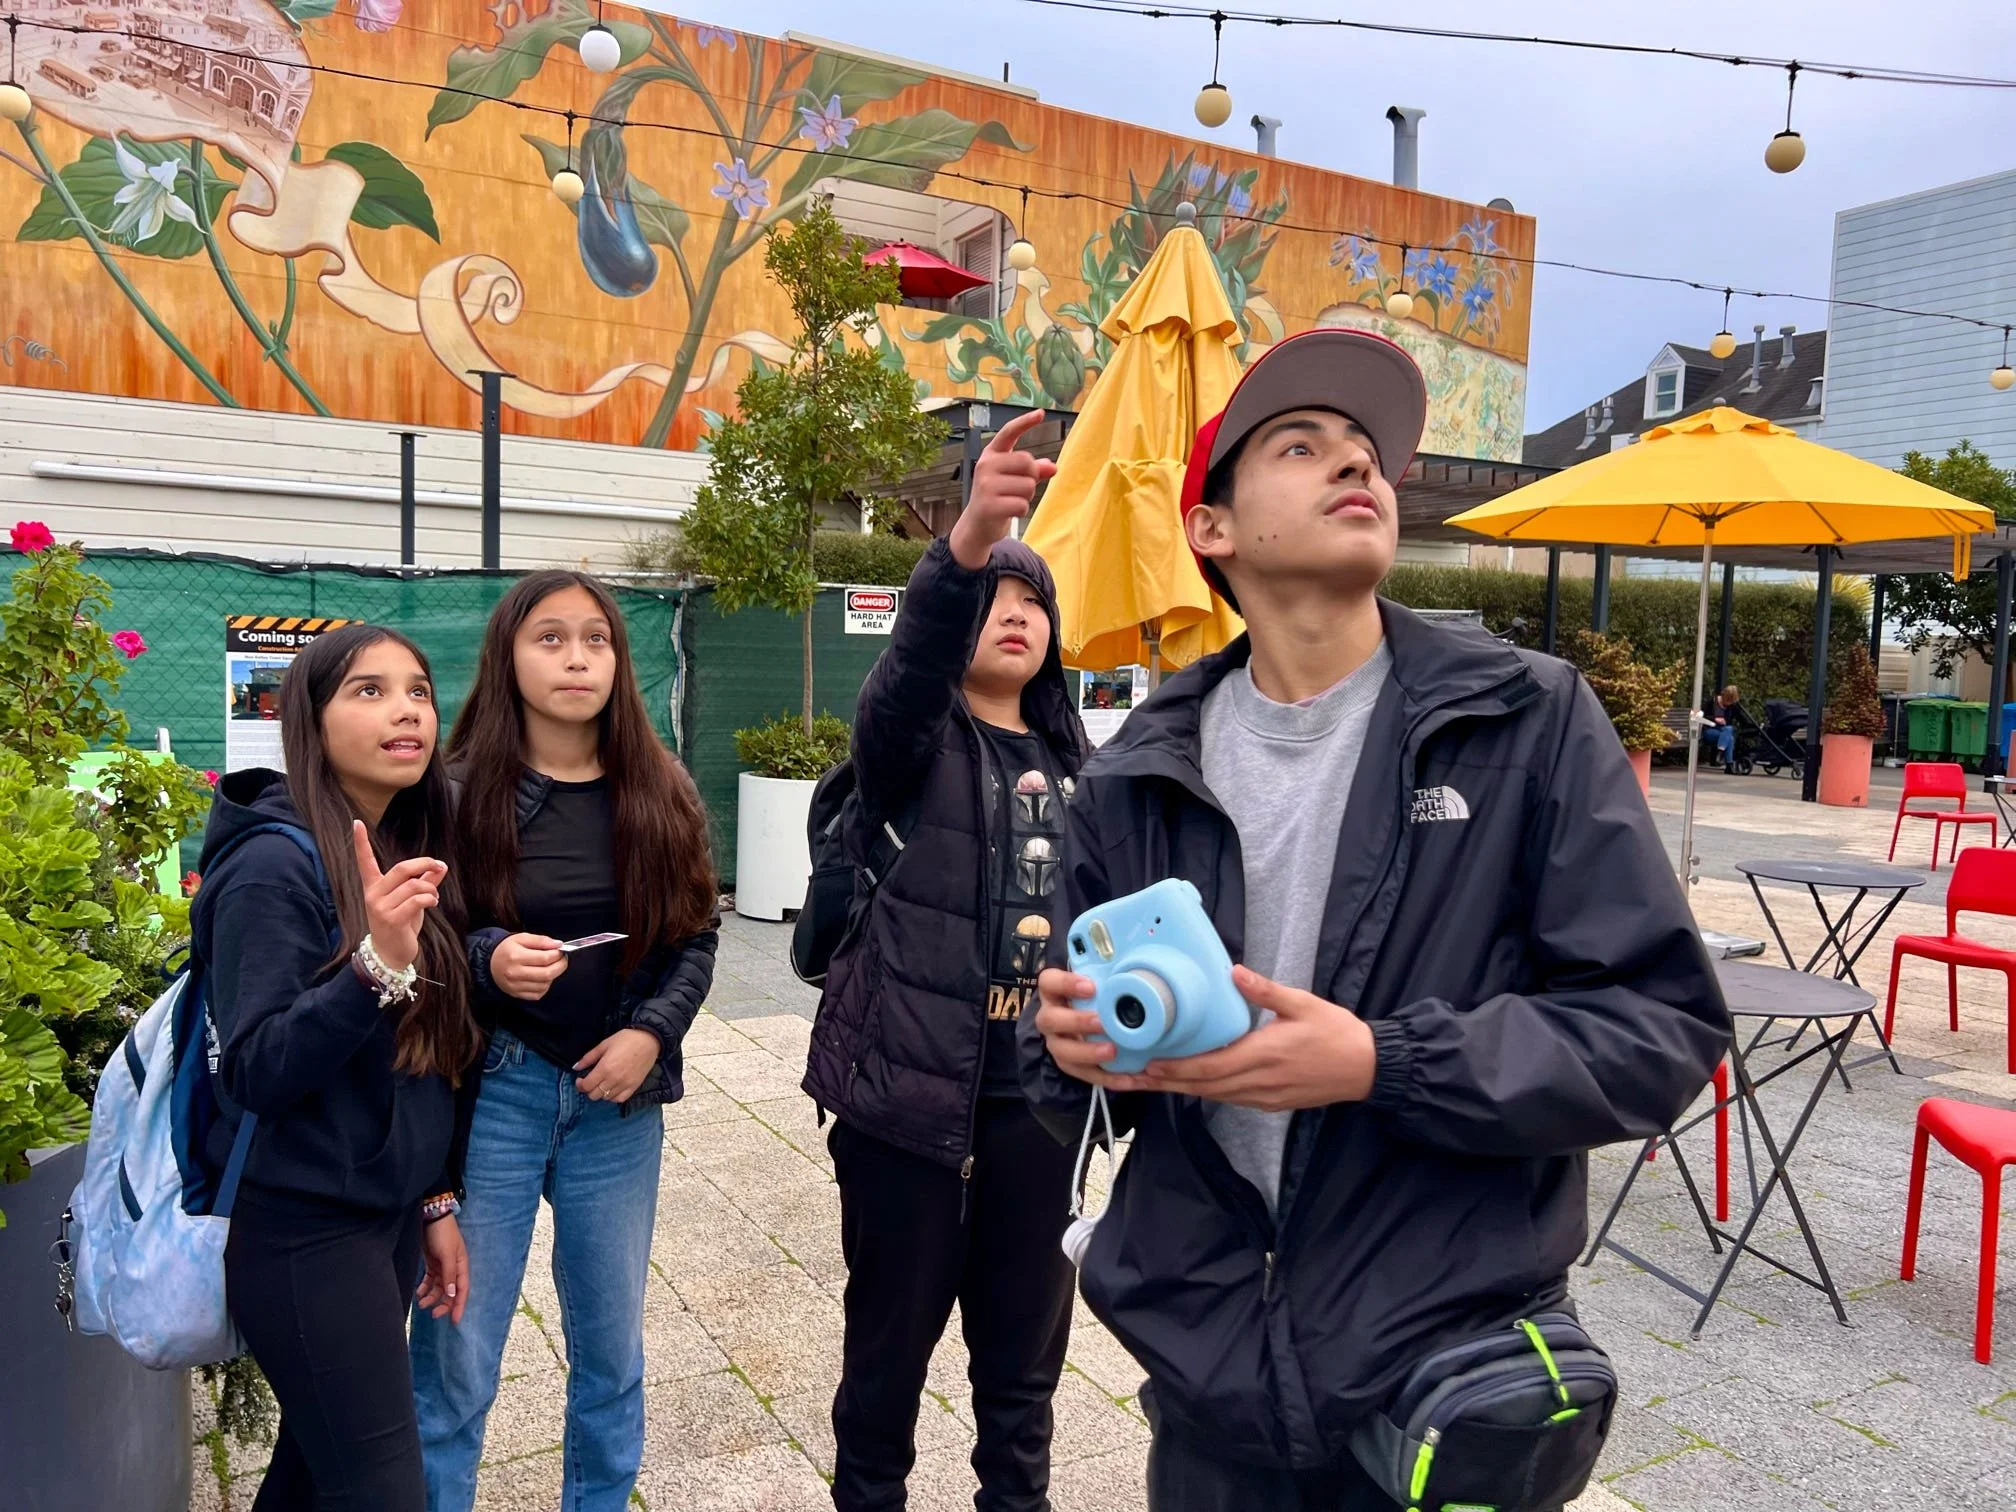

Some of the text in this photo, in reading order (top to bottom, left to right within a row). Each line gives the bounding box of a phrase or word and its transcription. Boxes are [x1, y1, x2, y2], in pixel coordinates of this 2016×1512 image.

[853, 596, 891, 607] DANGER
[876, 613, 892, 621] HAT
[861, 621, 883, 629] AREA
[238, 630, 295, 646] Coming
[1413, 787, 1442, 800] THE
[1410, 809, 1446, 824] FACE
[1016, 977, 1038, 985] THE
